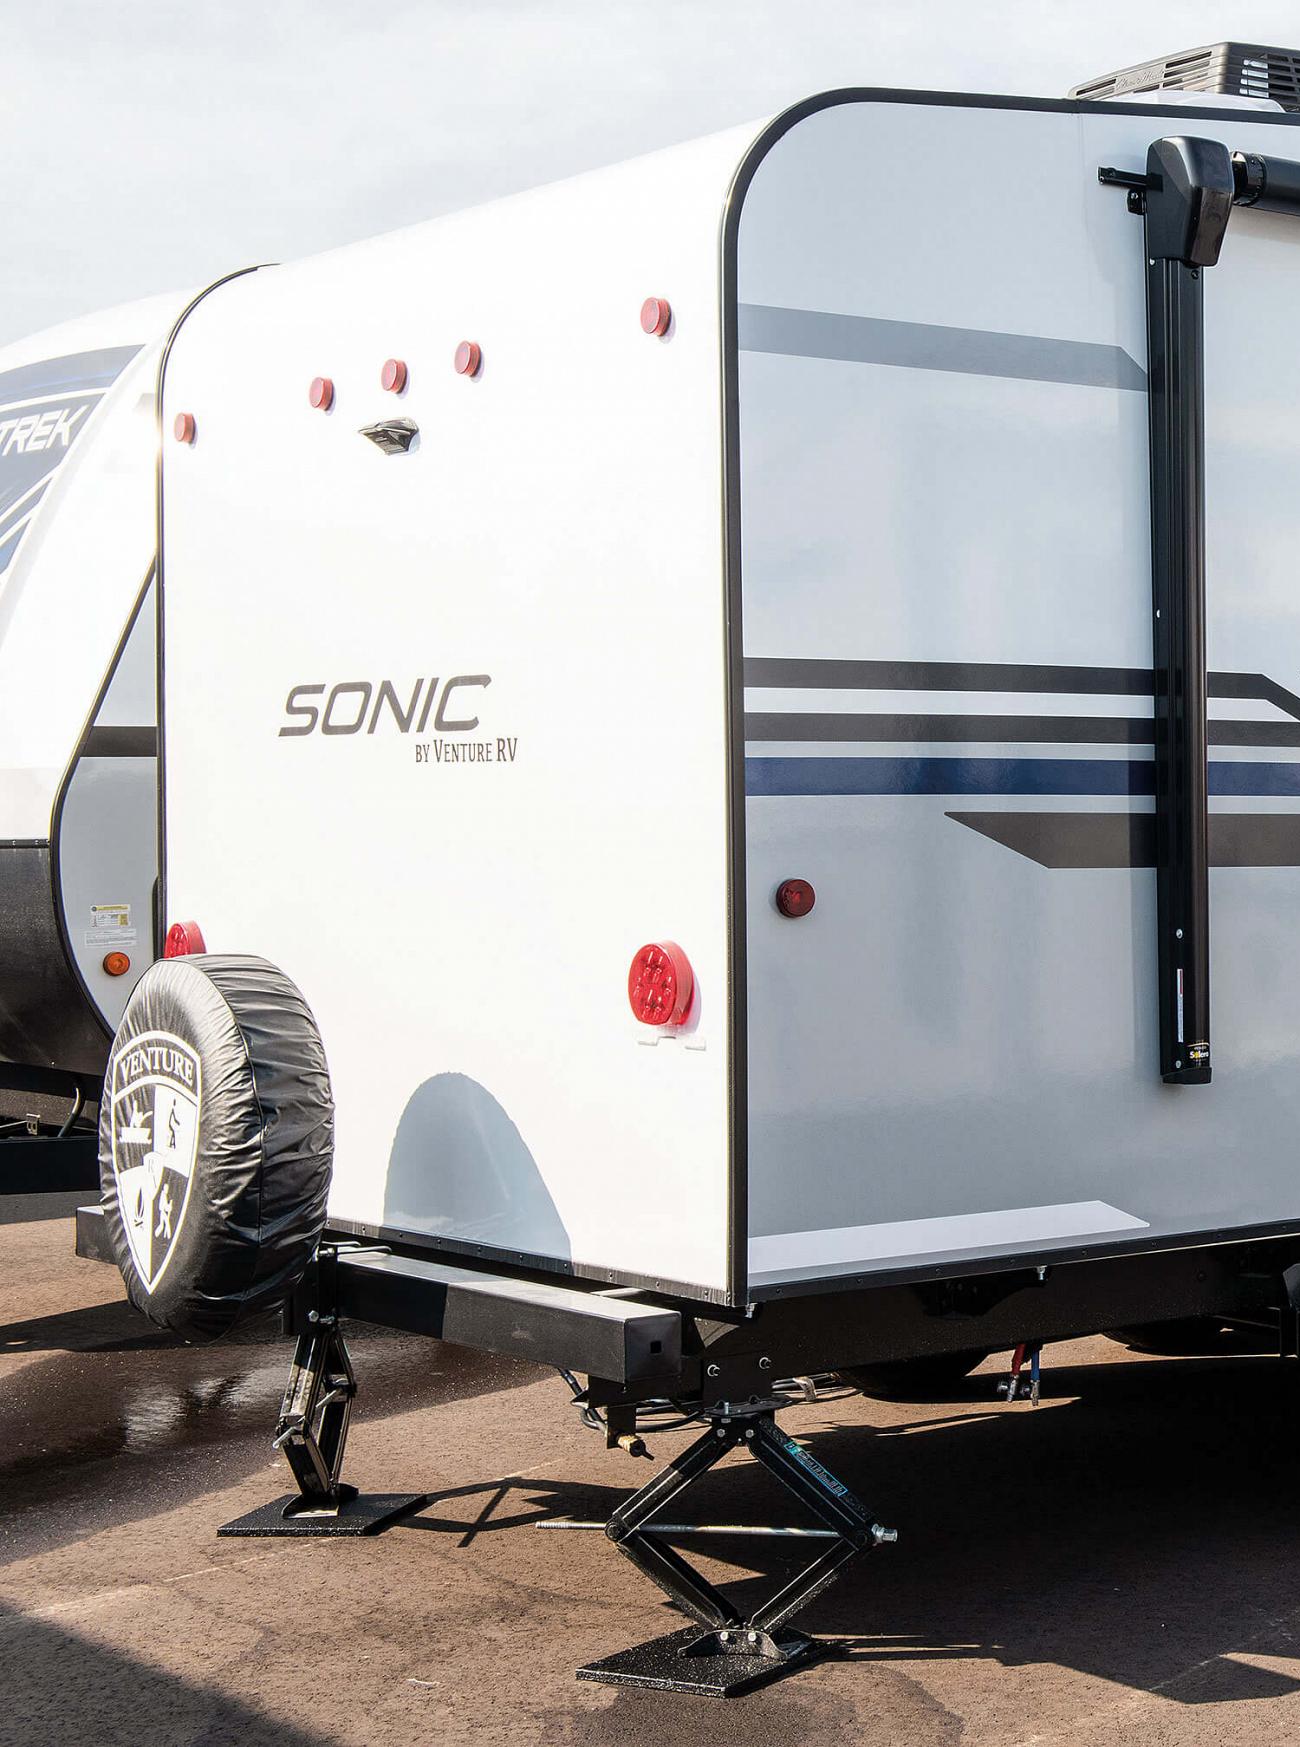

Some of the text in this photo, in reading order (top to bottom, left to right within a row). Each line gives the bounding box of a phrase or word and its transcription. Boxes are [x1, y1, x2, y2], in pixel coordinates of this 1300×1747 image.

[278, 674, 492, 737] SONIC
[495, 737, 518, 762] RV
[121, 1047, 194, 1087] VENTURE
